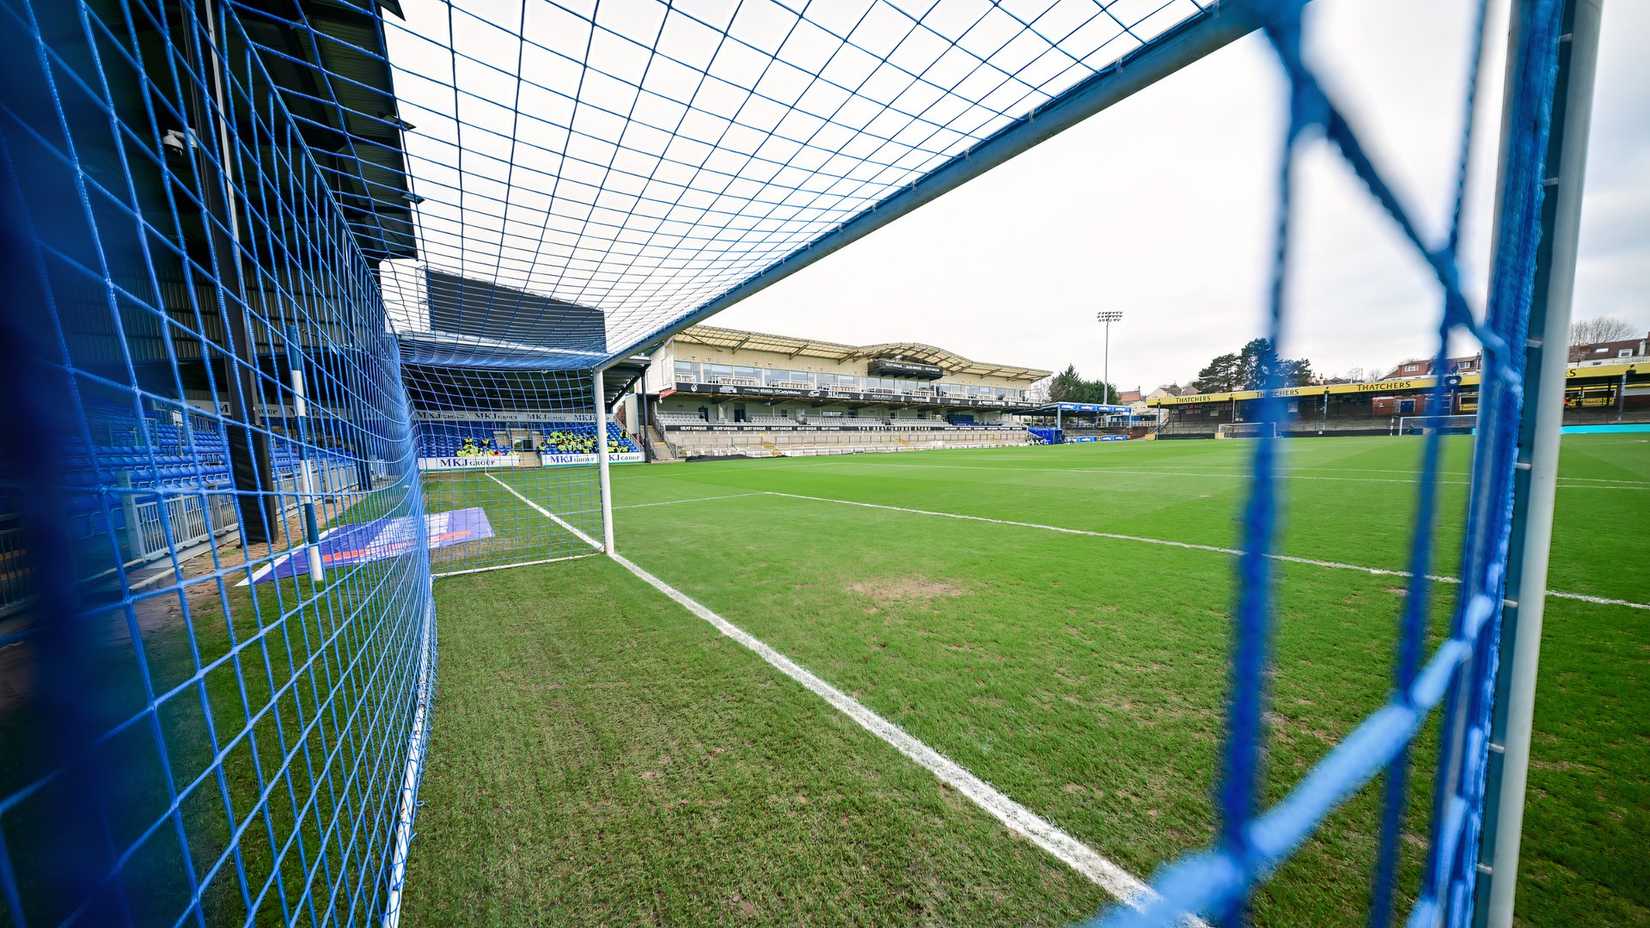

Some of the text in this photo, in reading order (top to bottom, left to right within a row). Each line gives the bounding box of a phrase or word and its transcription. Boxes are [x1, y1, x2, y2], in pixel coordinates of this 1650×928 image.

[1358, 381, 1411, 391] THATCHERS
[550, 455, 572, 463] MKJ
[608, 454, 620, 462] KJ
[440, 459, 468, 467] MKJ
